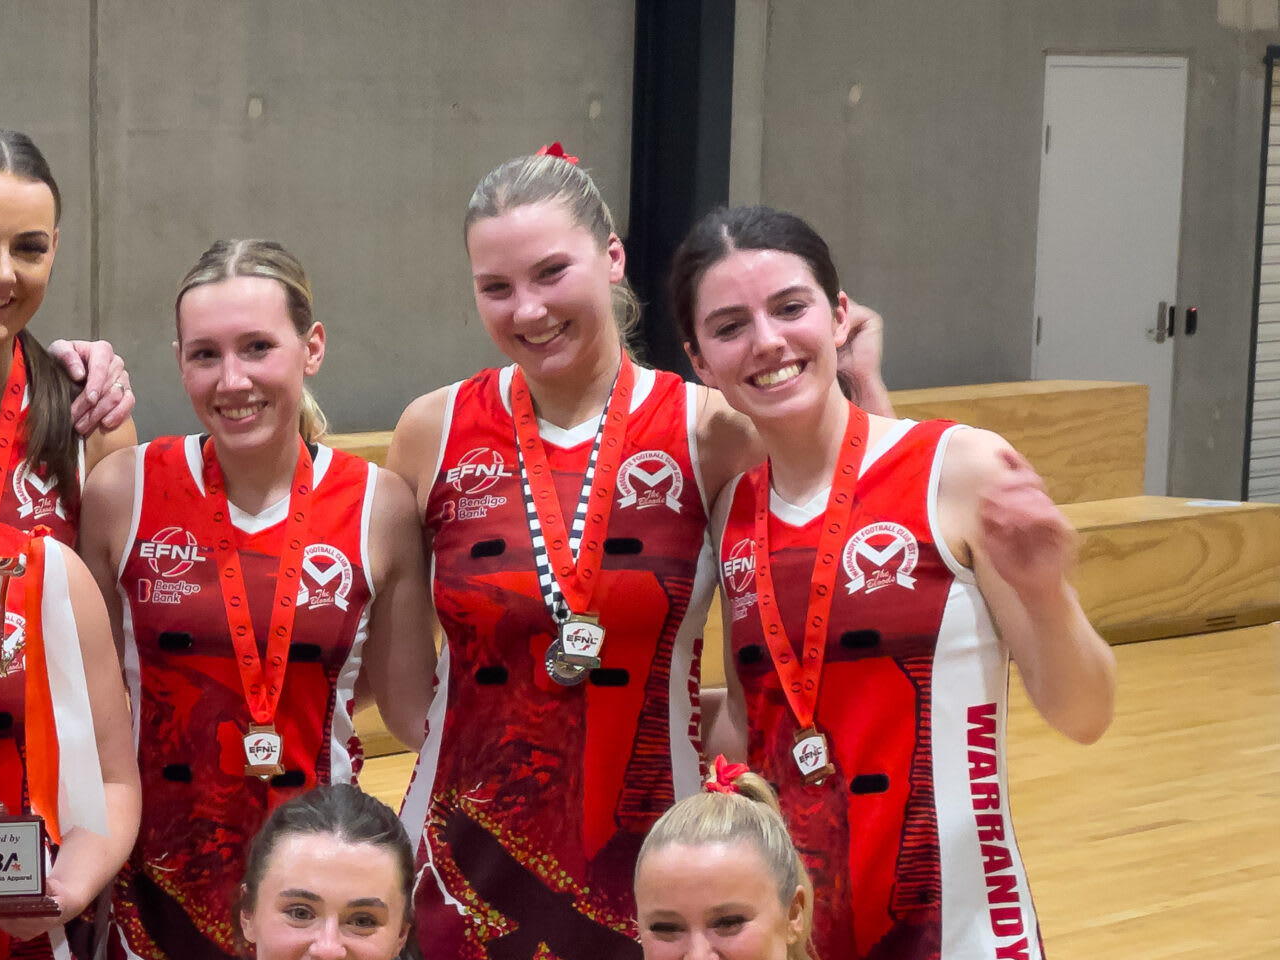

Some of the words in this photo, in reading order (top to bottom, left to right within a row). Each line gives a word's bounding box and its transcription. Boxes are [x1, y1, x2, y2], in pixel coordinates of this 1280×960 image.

[446, 464, 512, 483] EFNL
[459, 495, 507, 508] Bendigo
[458, 507, 487, 520] Bank
[861, 524, 896, 537] FOOTBALL
[897, 528, 911, 542] CLUB
[140, 543, 206, 562] EFNL
[306, 546, 335, 556] FOOTBALL
[872, 569, 889, 579] The
[154, 579, 201, 595] Bendigo
[152, 592, 181, 603] Bank
[566, 634, 597, 645] EFNL
[248, 746, 277, 754] EFNL
[9, 834, 21, 844] by
[7, 874, 32, 882] Apparel
